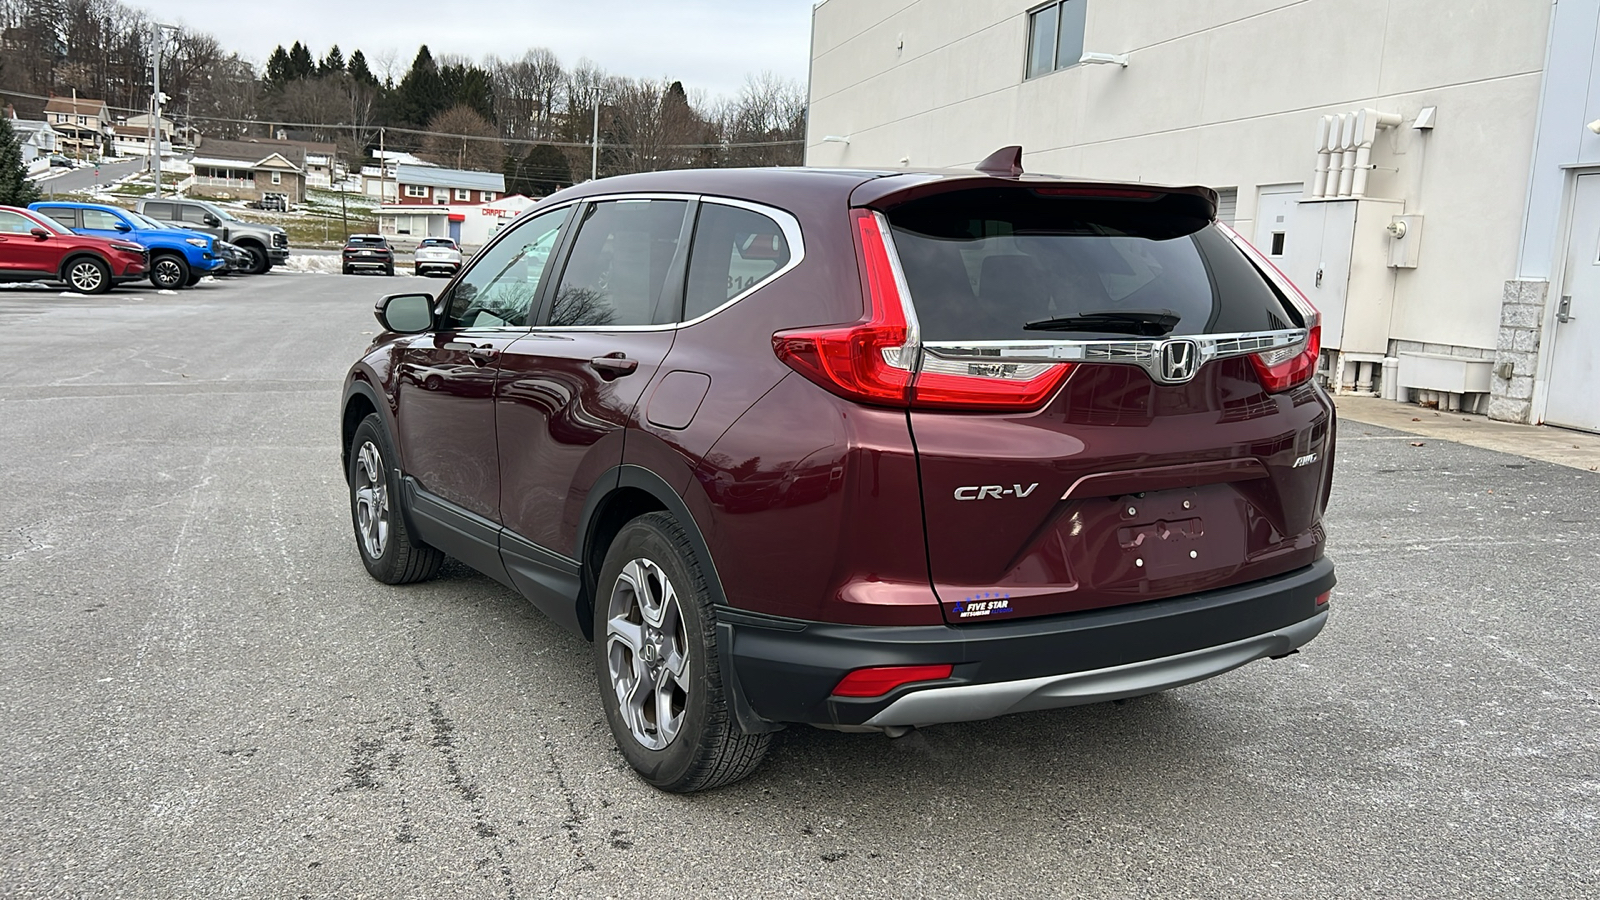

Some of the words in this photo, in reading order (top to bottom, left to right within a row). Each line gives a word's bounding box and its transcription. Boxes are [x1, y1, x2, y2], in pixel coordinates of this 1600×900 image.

[482, 208, 507, 218] CARPET
[954, 482, 1039, 501] CR-V
[966, 602, 987, 612] FIVE
[987, 600, 1009, 610] STAR
